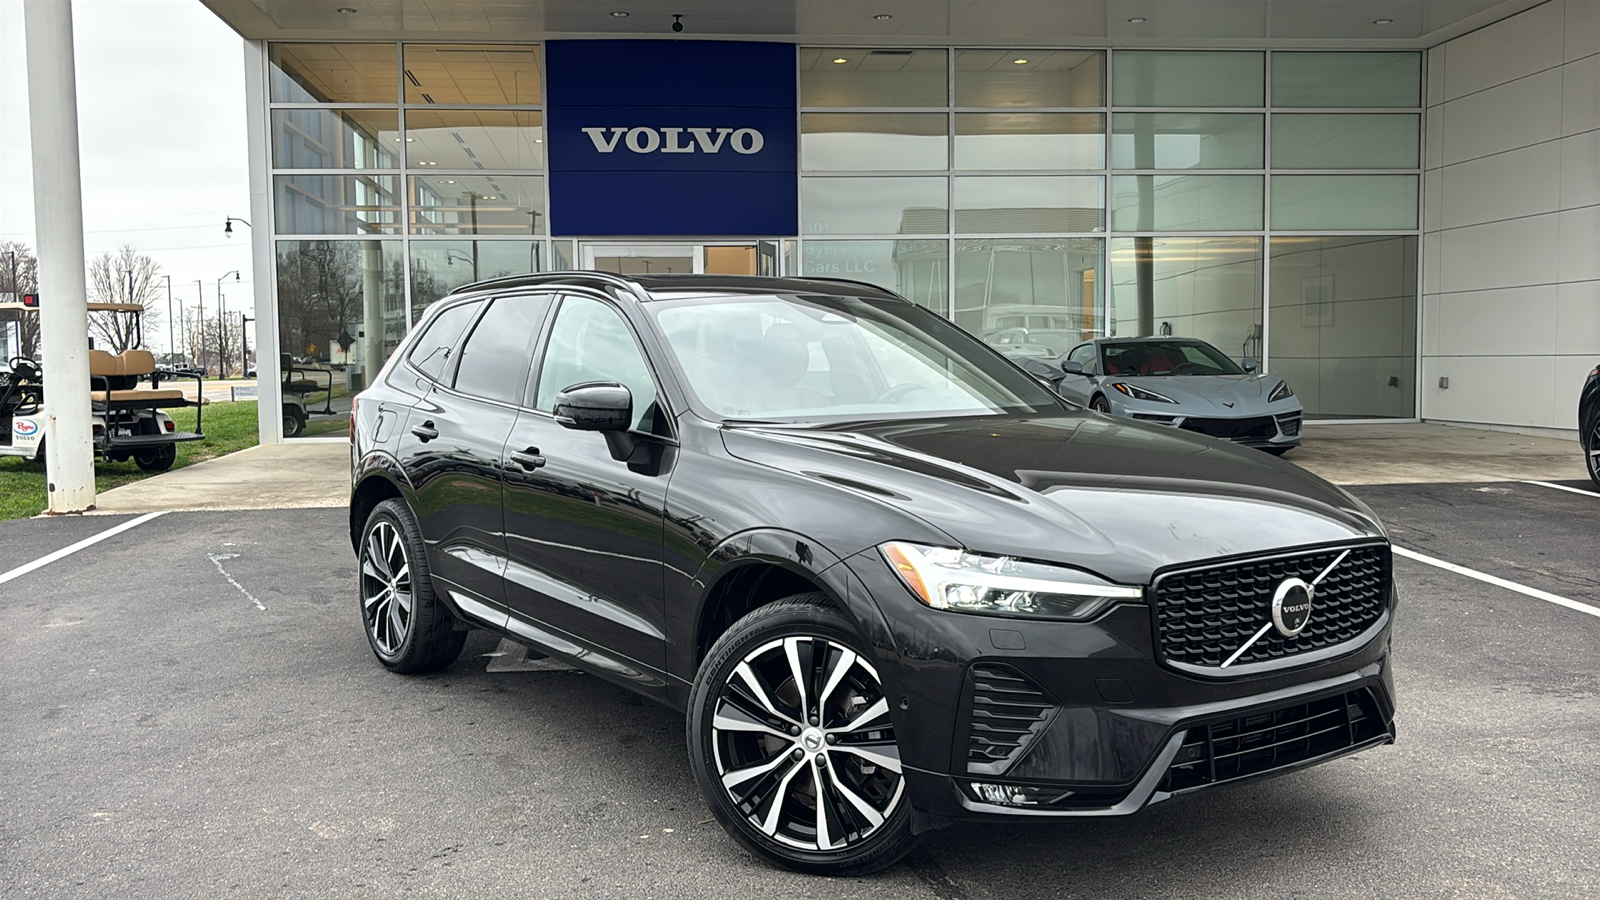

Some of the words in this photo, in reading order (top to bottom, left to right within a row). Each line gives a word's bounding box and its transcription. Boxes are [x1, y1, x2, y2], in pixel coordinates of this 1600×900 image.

[581, 126, 764, 154] VOLVO
[805, 242, 848, 258] Byers
[804, 261, 840, 274] Cars
[845, 260, 875, 273] LLC
[1282, 603, 1309, 613] VOLVO
[705, 625, 766, 686] CONTINENTAL
